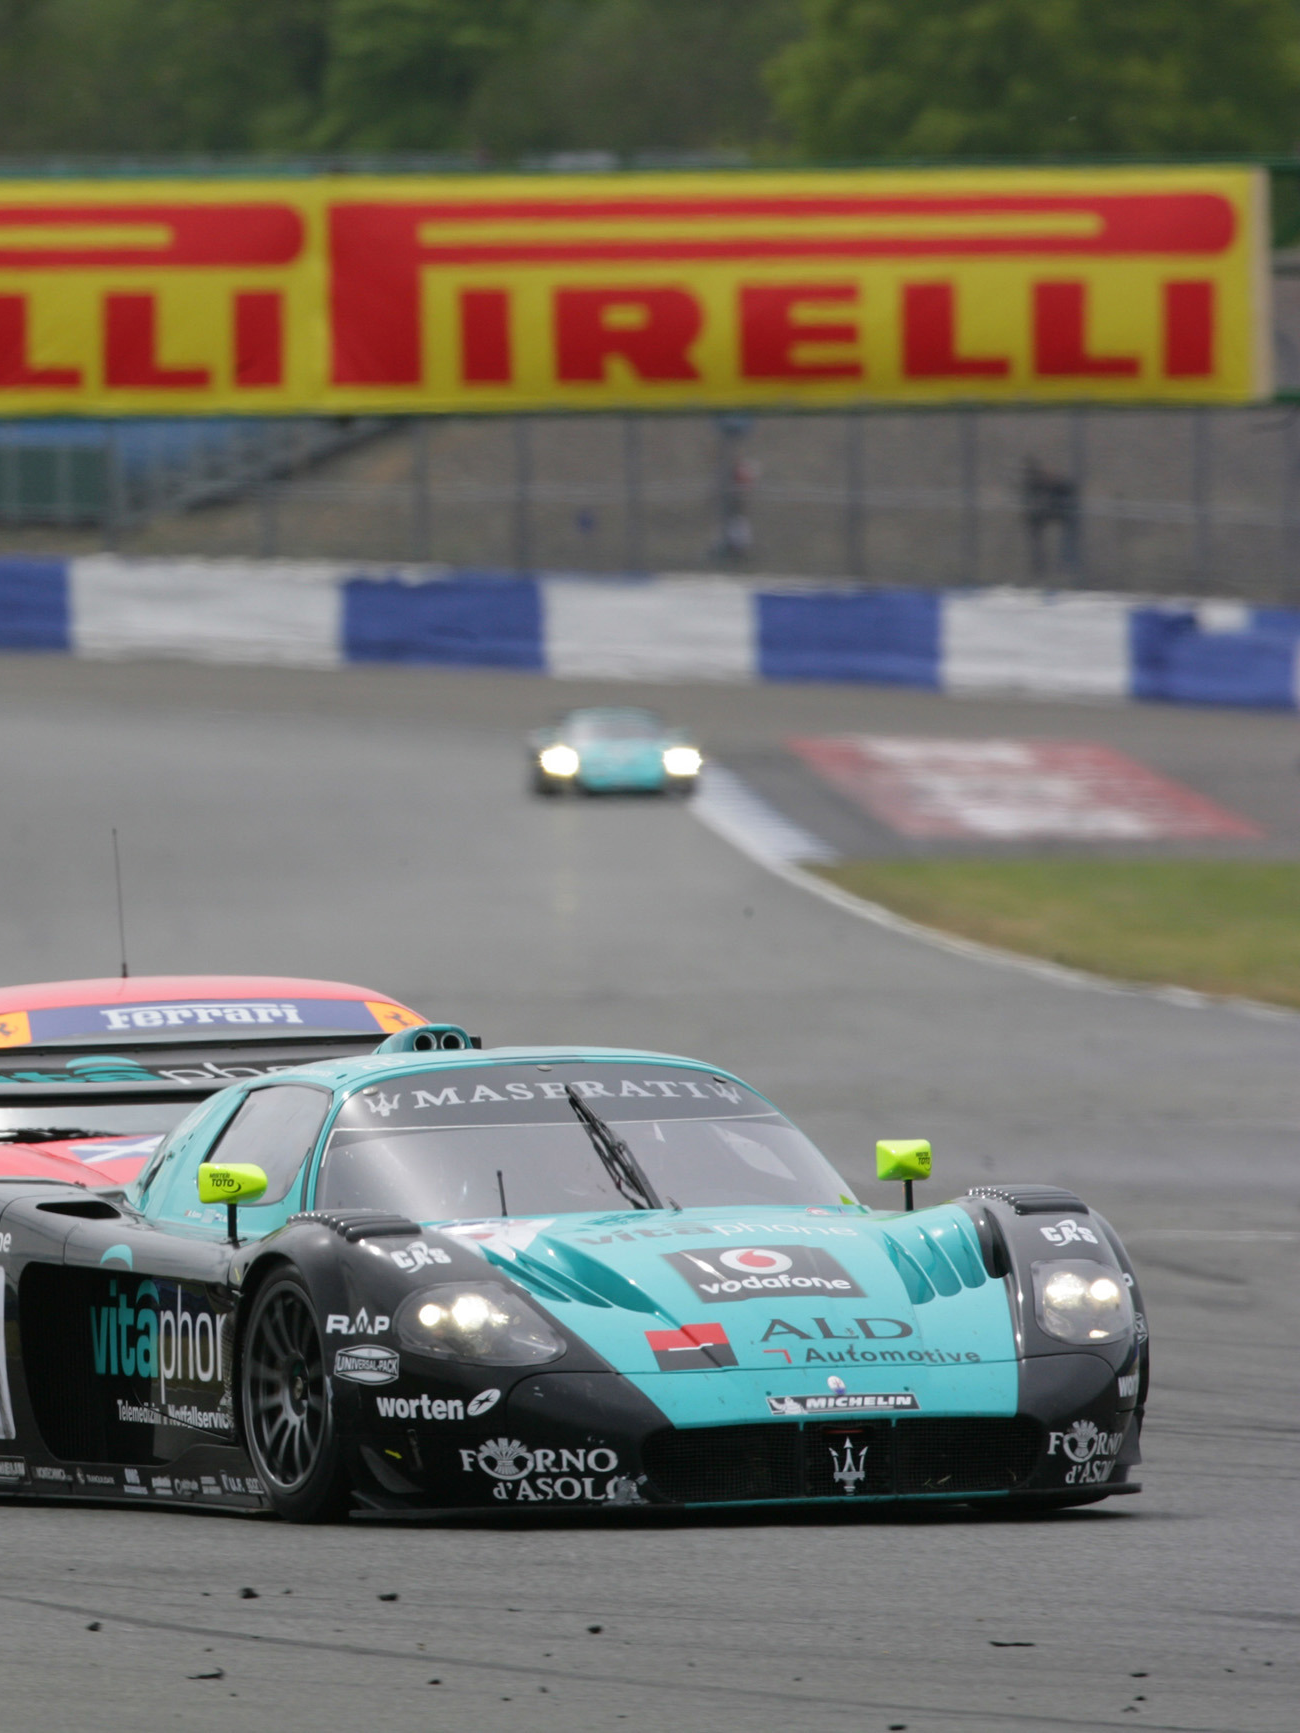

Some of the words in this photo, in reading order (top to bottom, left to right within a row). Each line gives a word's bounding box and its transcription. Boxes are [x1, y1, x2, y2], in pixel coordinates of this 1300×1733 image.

[329, 193, 1235, 386] PIRELLI
[101, 1003, 304, 1030] Ferrari
[413, 1079, 704, 1110] MASERATI
[211, 1178, 234, 1187] TOTO
[578, 1221, 859, 1245] vitaphone
[699, 1274, 851, 1295] vodafone
[760, 1317, 914, 1343] ALD
[337, 1354, 398, 1373] UNIVERSAL-PACK
[805, 1346, 982, 1365] Automotive
[116, 1399, 162, 1424] Telemedizin
[376, 1393, 465, 1420] worten
[806, 1395, 912, 1408] MICHELIN
[1047, 1419, 1124, 1462] FORNO
[459, 1438, 619, 1481] FORNO
